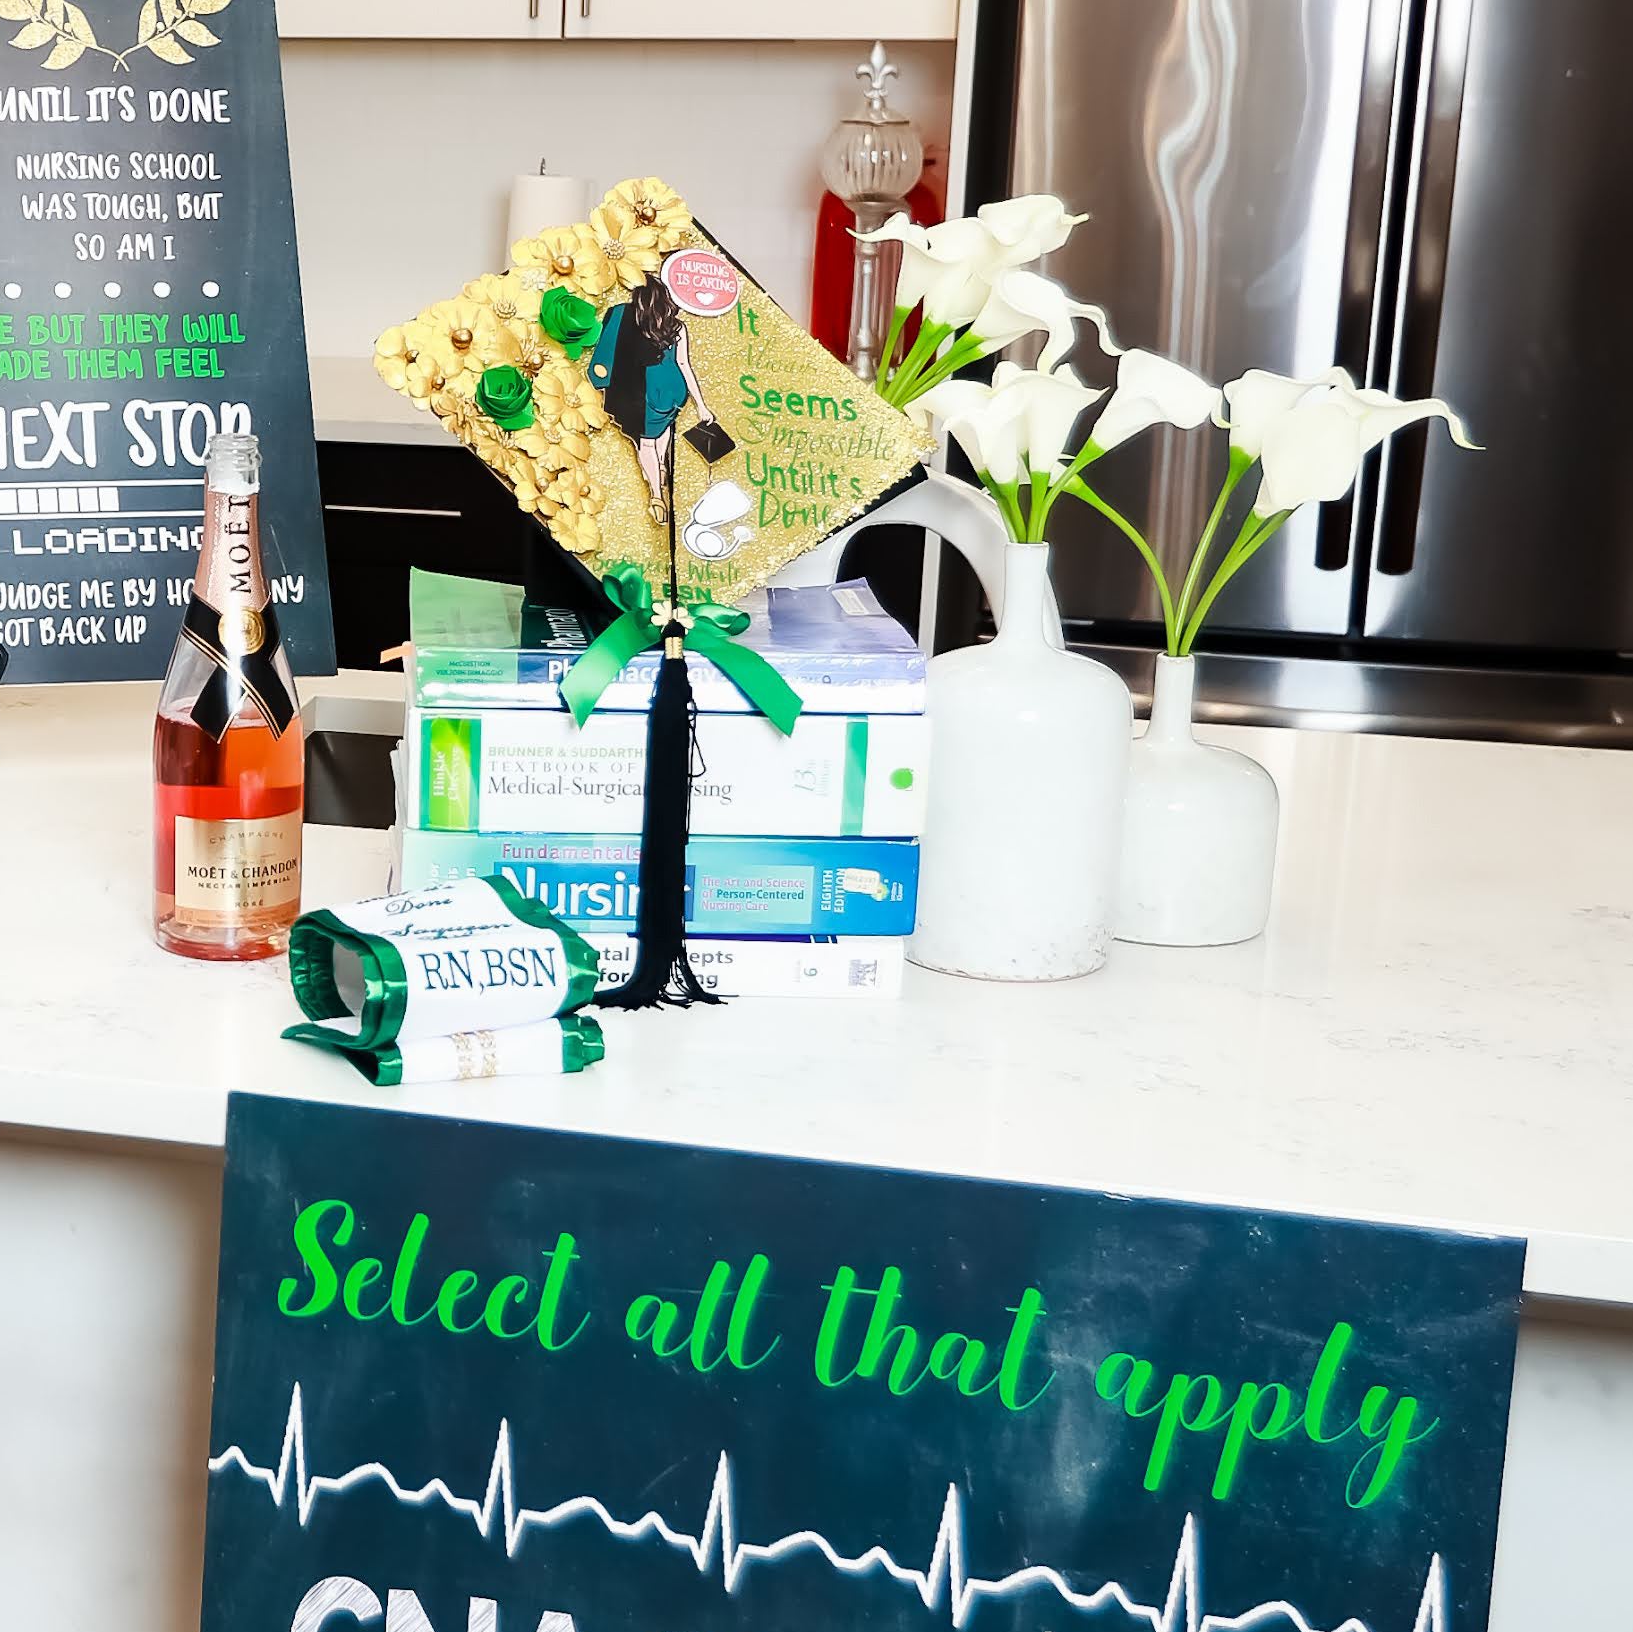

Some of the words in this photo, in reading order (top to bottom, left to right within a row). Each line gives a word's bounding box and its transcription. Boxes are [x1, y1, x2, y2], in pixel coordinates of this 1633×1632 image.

[87, 85, 136, 123] IT'S
[150, 88, 230, 123] DONE
[16, 153, 121, 182] NURSING
[129, 153, 221, 181] SCHOOL
[22, 194, 77, 221] WAS
[84, 193, 168, 223] TOUGH,
[175, 193, 223, 220] BUT
[75, 233, 107, 261] SO
[116, 233, 153, 261] AM
[162, 233, 176, 261] I
[676, 273, 690, 285] IS
[692, 275, 736, 293] CARING
[681, 260, 730, 277] NURSING
[28, 315, 86, 346] BUT
[100, 315, 172, 346] THEY
[185, 314, 245, 344] WILL
[736, 303, 760, 337] It
[62, 350, 143, 381] THEM
[157, 349, 224, 379] FEEL
[739, 375, 858, 421] Seems
[80, 579, 116, 608] ME
[123, 578, 156, 606] BY
[167, 577, 196, 606] HO
[269, 575, 304, 603] NY
[39, 617, 106, 646] BACK
[114, 615, 147, 643] UP
[489, 746, 553, 757] BRUNNER
[488, 762, 599, 773] TEXTBOOK
[611, 763, 637, 773] OF
[488, 776, 645, 804] Medical-Surgica
[502, 844, 640, 860] Fundamentals
[230, 869, 238, 879] &
[242, 858, 297, 878] CHANDON
[501, 867, 640, 917] Nursin
[821, 870, 833, 910] EIGHTH
[417, 947, 556, 995] RN,BSN
[600, 967, 630, 982] for
[275, 1198, 598, 1355] Select
[624, 1253, 779, 1374] all
[813, 1262, 1052, 1413] that
[1092, 1320, 1444, 1512] apply
